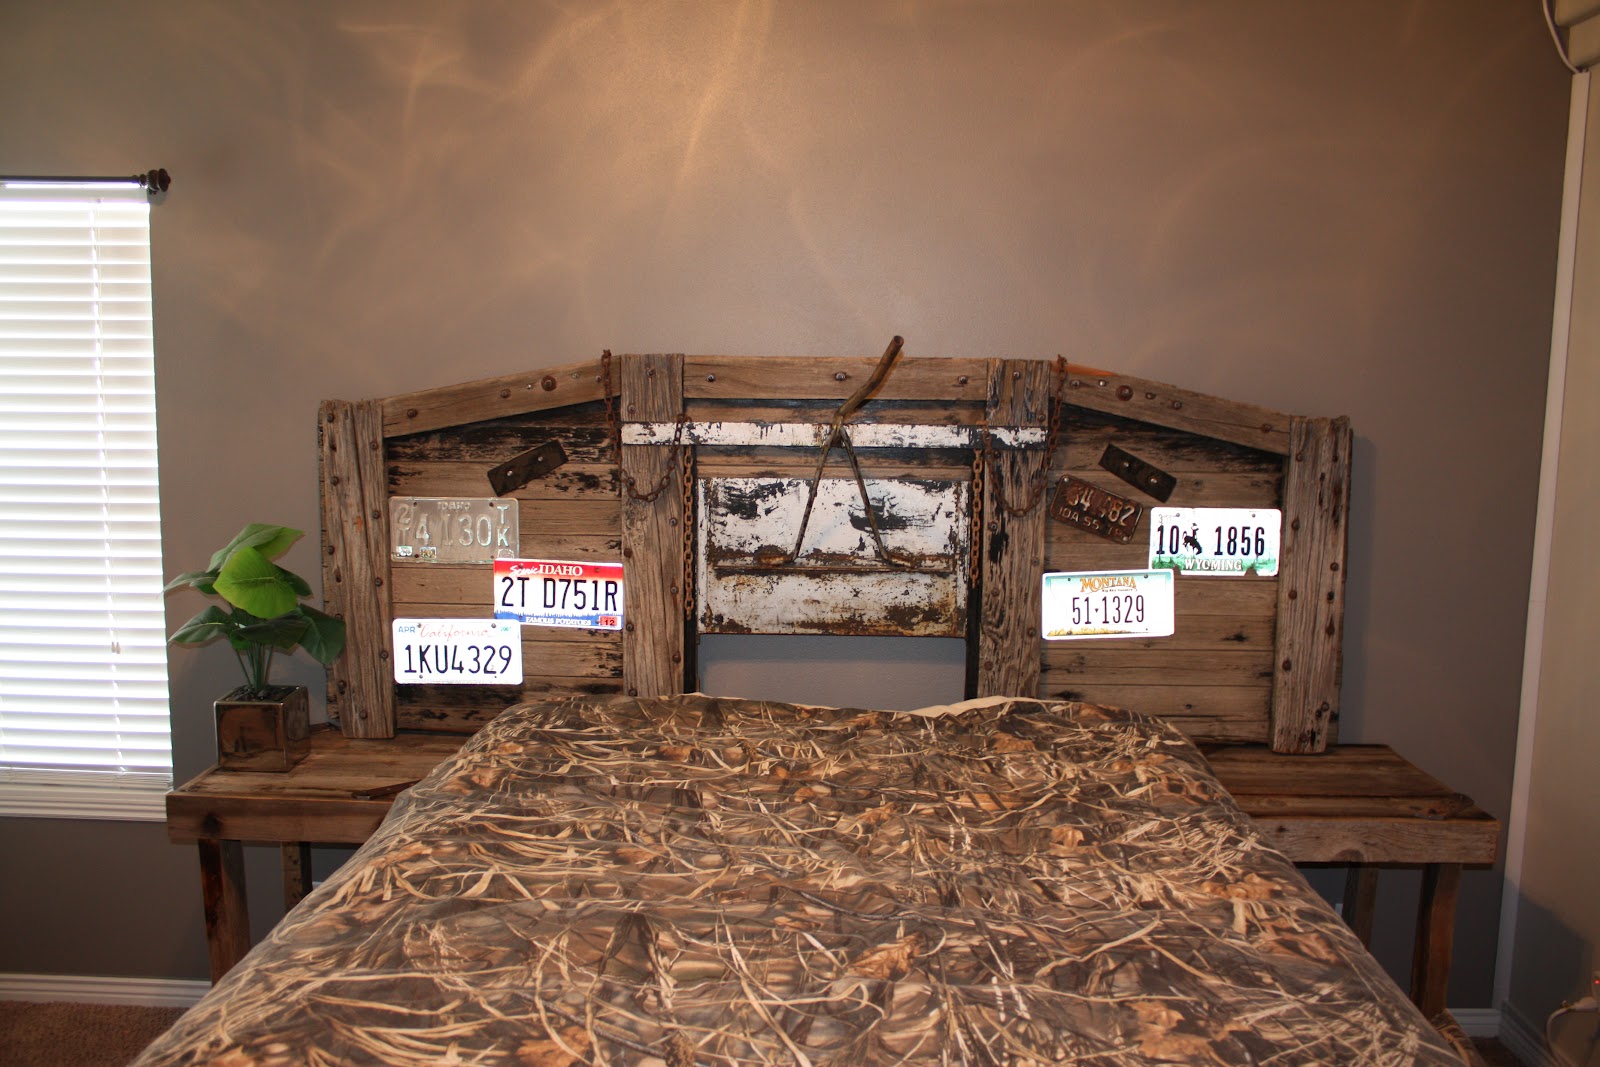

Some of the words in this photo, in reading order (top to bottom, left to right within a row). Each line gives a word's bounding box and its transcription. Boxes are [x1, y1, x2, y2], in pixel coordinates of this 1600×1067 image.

[437, 501, 471, 510] IDAHO
[1156, 525, 1180, 555] 10
[1214, 526, 1265, 556] 1856
[509, 564, 540, 577] Scenic
[539, 564, 583, 576] IDAHO
[1184, 558, 1242, 571] WYOMING
[501, 576, 530, 608] 2T
[543, 577, 618, 612] D751R
[420, 623, 495, 642] California
[404, 645, 512, 674] 1KU4329
